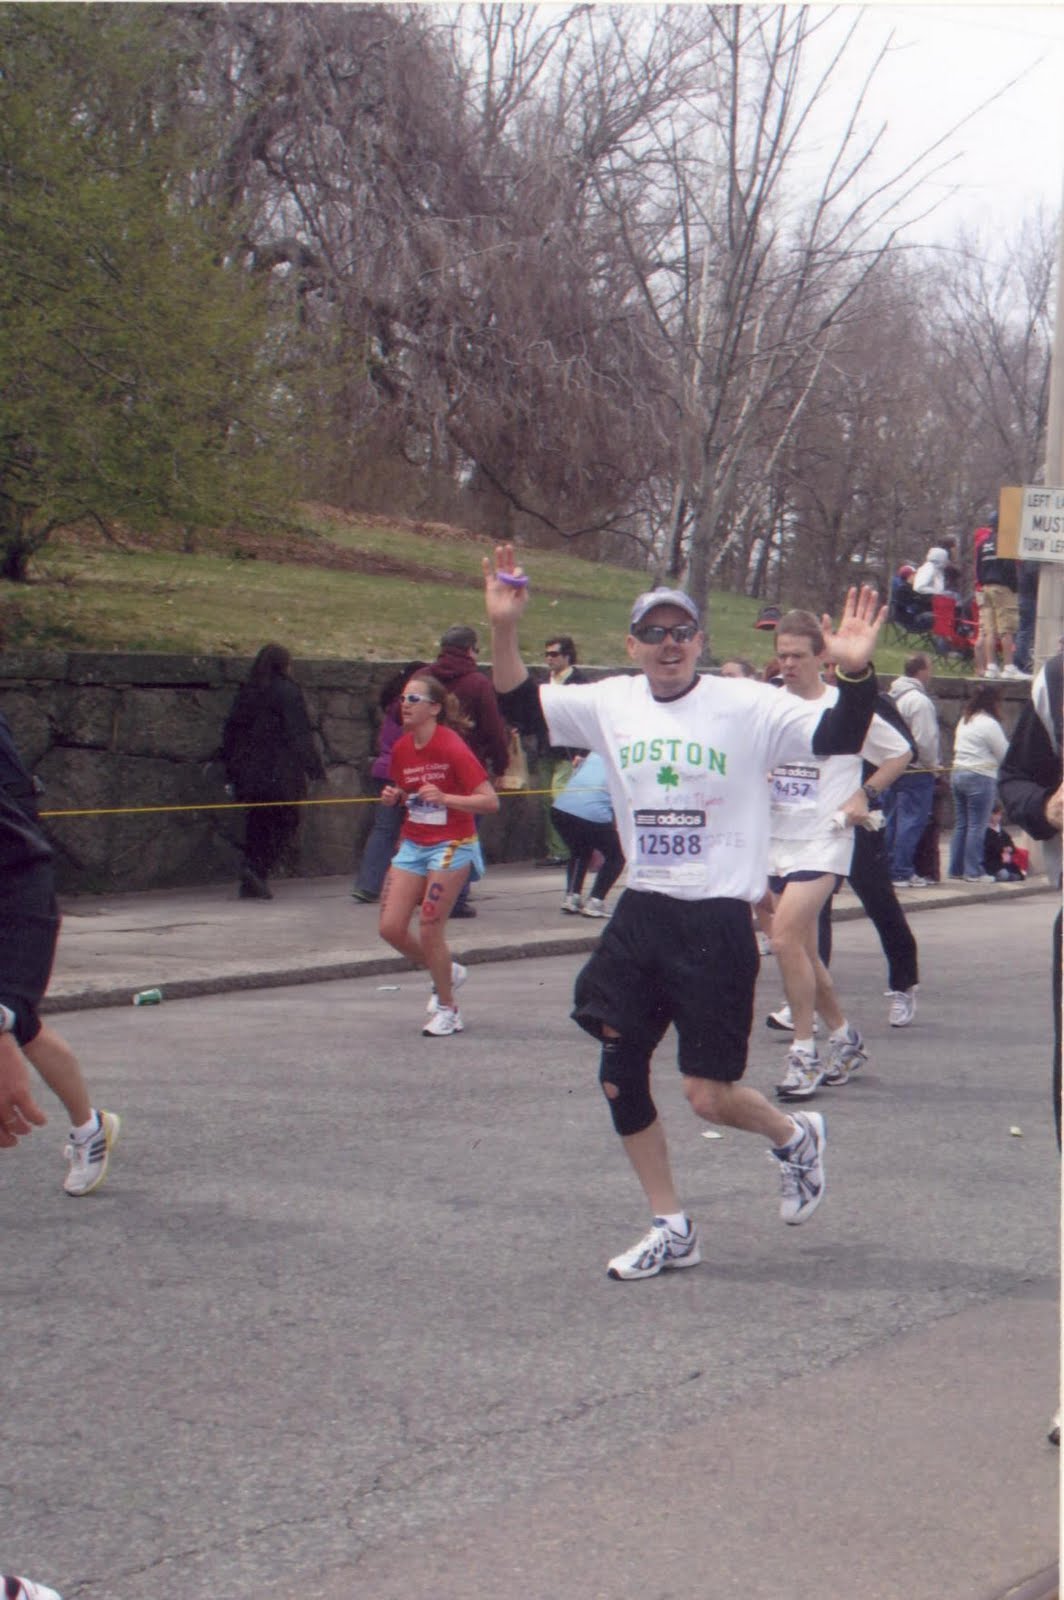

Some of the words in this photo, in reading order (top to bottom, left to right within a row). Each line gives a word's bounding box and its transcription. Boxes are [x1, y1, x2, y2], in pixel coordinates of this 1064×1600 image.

[1027, 494, 1051, 508] LEFT
[620, 738, 727, 776] BOSTON
[657, 812, 702, 825] adidas
[638, 834, 702, 856] 12588
